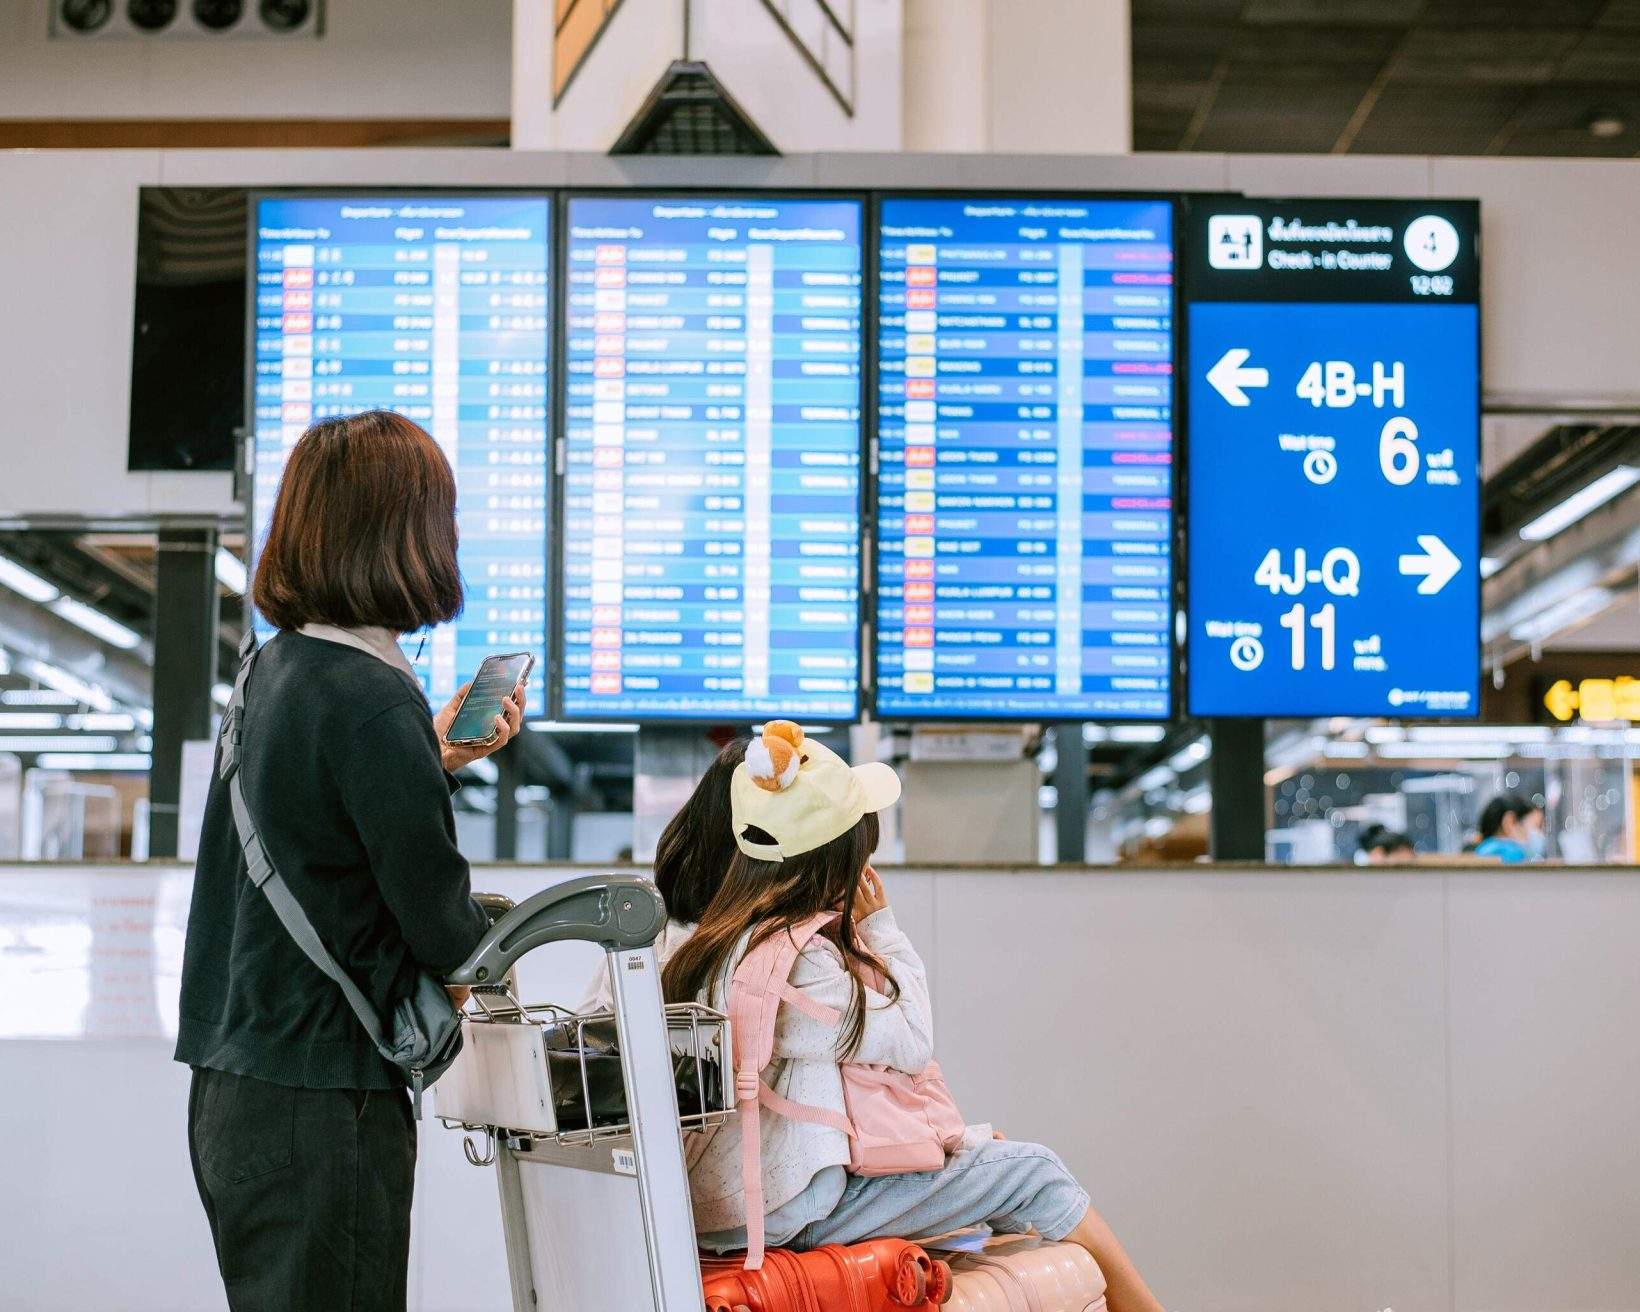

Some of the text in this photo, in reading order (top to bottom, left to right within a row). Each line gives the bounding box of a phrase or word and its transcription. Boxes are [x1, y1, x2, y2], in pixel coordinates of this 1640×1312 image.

[1268, 250, 1313, 270] Check
[1337, 250, 1393, 270] Counter
[1296, 361, 1405, 408] 4B-H
[1379, 416, 1420, 486] 6
[1254, 547, 1361, 597] 4J-Q
[1279, 603, 1335, 671] 11
